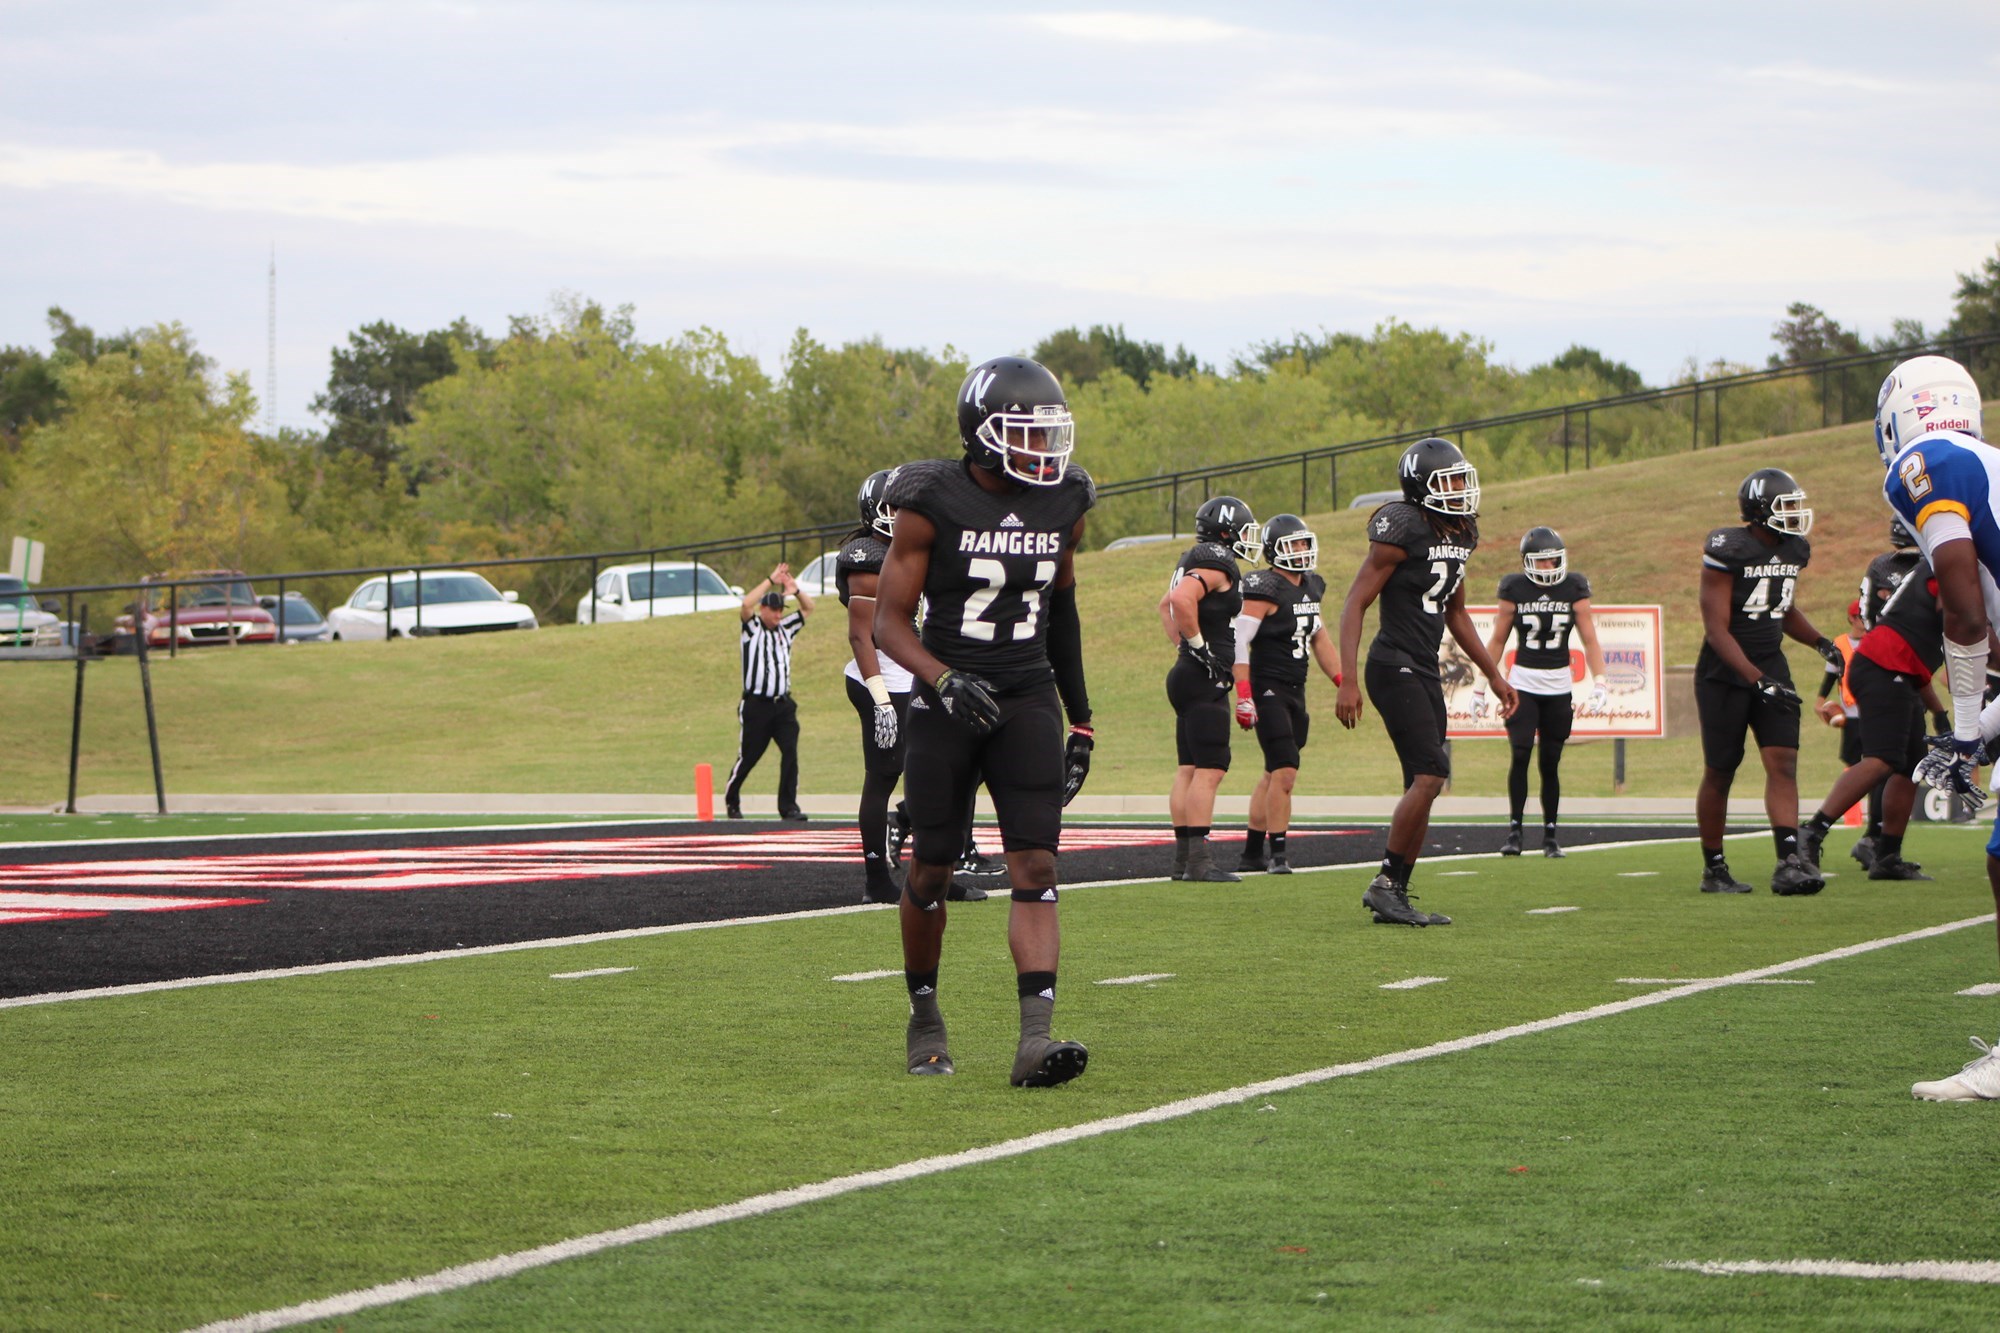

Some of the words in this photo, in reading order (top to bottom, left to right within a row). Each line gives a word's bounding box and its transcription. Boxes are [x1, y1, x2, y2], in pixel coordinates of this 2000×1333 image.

[965, 369, 997, 408] N
[1952, 393, 1959, 406] 2
[1925, 419, 1970, 433] Riddell
[1402, 453, 1419, 478] N
[1899, 452, 1932, 503] 2
[861, 479, 876, 501] N
[1748, 479, 1765, 500] N
[1218, 504, 1236, 526] N
[958, 530, 1060, 555] RANGERS
[1426, 545, 1471, 561] RANGERS
[1743, 564, 1799, 579] RANGERS
[960, 558, 1057, 642] 23
[1517, 601, 1570, 614] RANGERS
[1521, 613, 1570, 650] 25
[1924, 787, 1952, 820] G
